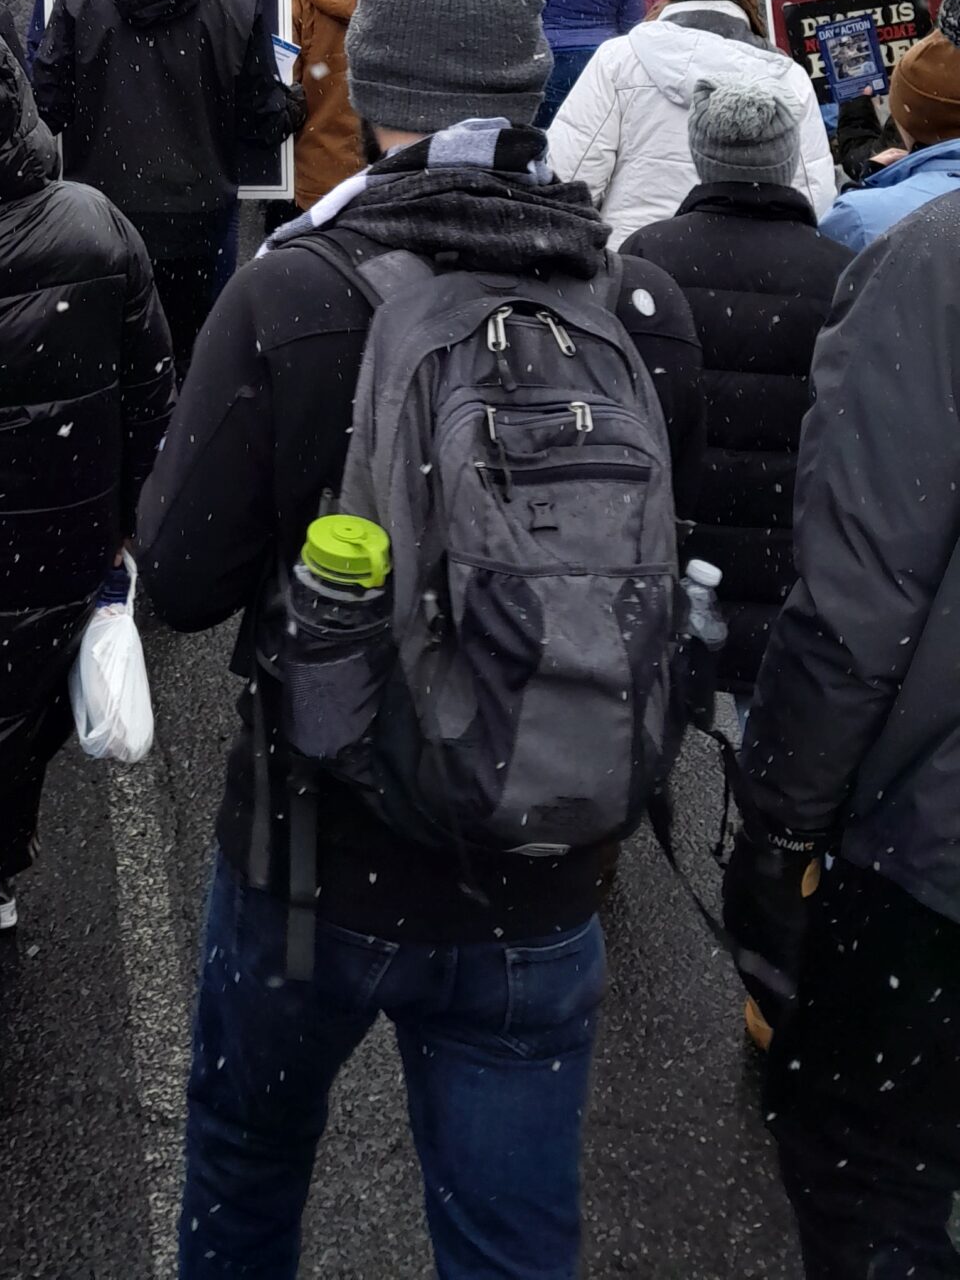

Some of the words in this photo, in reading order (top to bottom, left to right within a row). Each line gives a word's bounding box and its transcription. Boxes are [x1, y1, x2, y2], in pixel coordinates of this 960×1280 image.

[889, 2, 916, 24] IS
[819, 28, 835, 40] DAY
[841, 20, 871, 35] ACTION
[878, 23, 917, 41] COME
